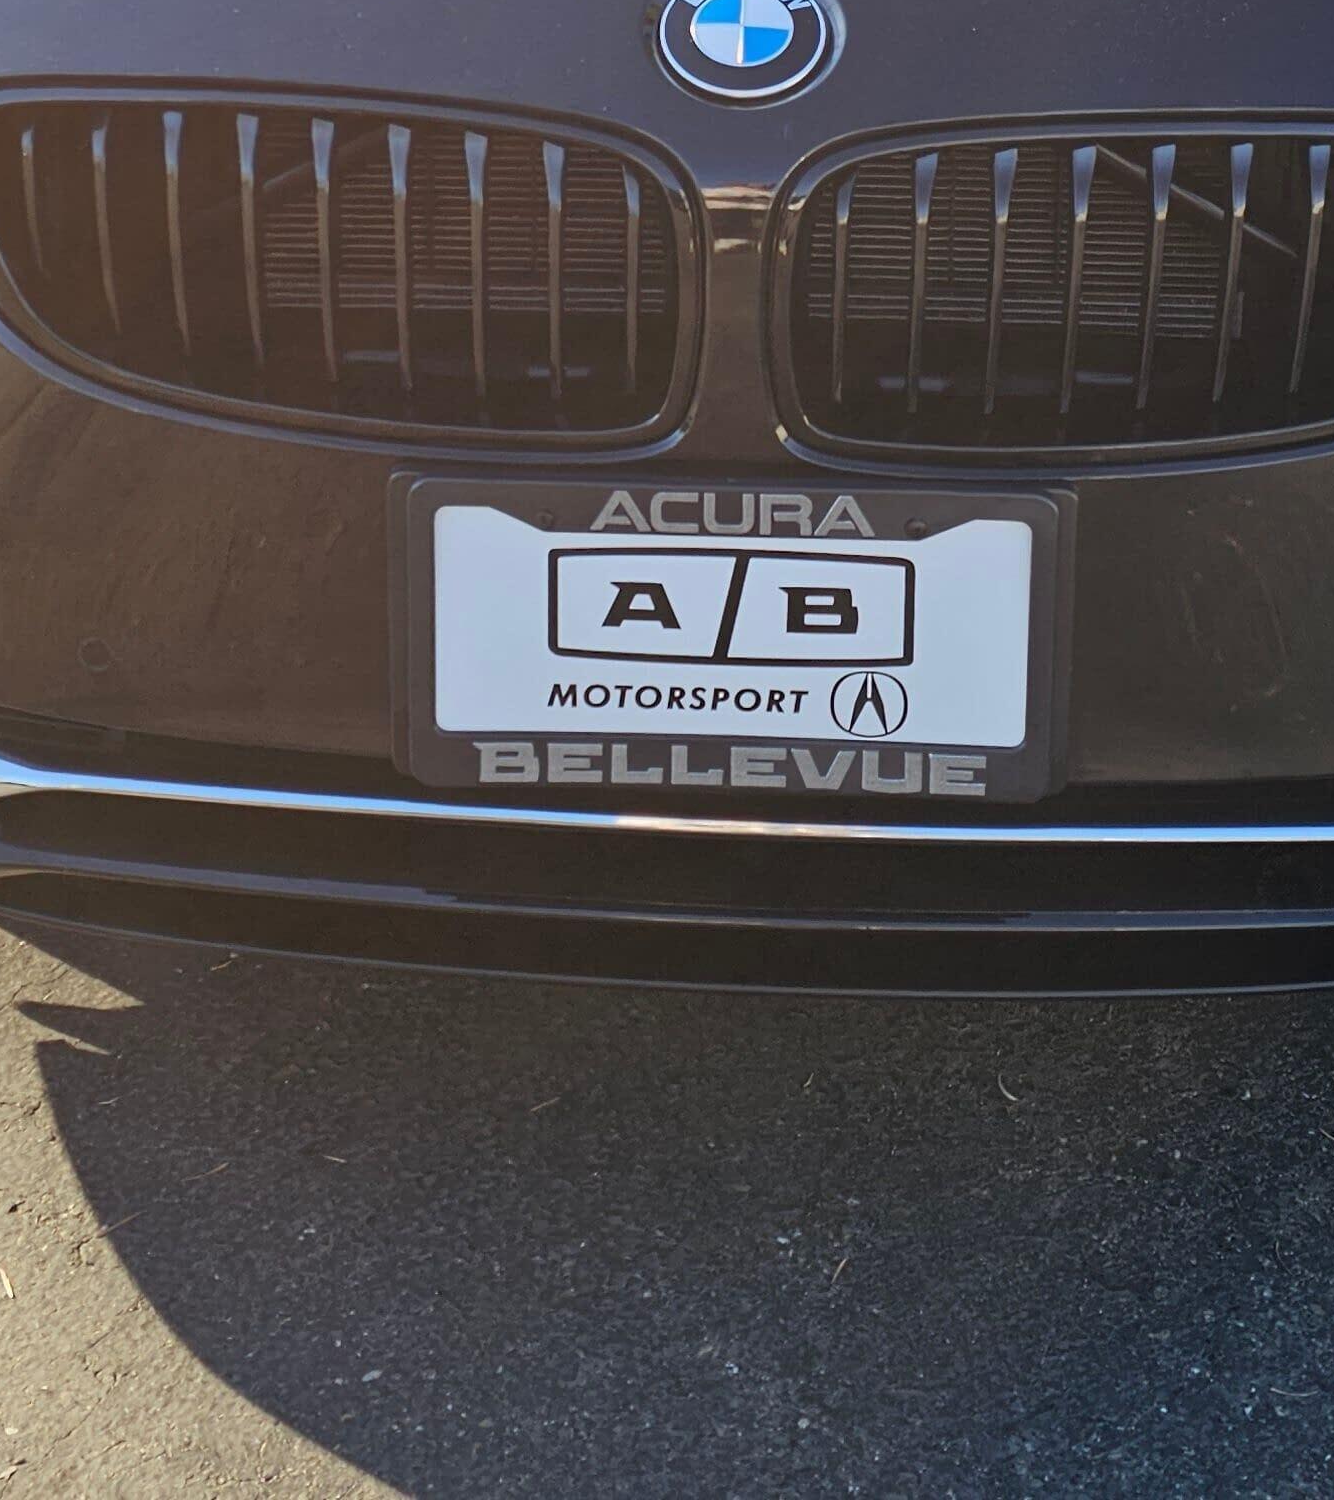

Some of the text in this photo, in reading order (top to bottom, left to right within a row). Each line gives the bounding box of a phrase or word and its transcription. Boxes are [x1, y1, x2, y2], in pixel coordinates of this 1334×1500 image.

[590, 490, 877, 538] ACURA
[547, 683, 809, 714] MOTORSPORT
[472, 741, 988, 797] BELLEVUE
